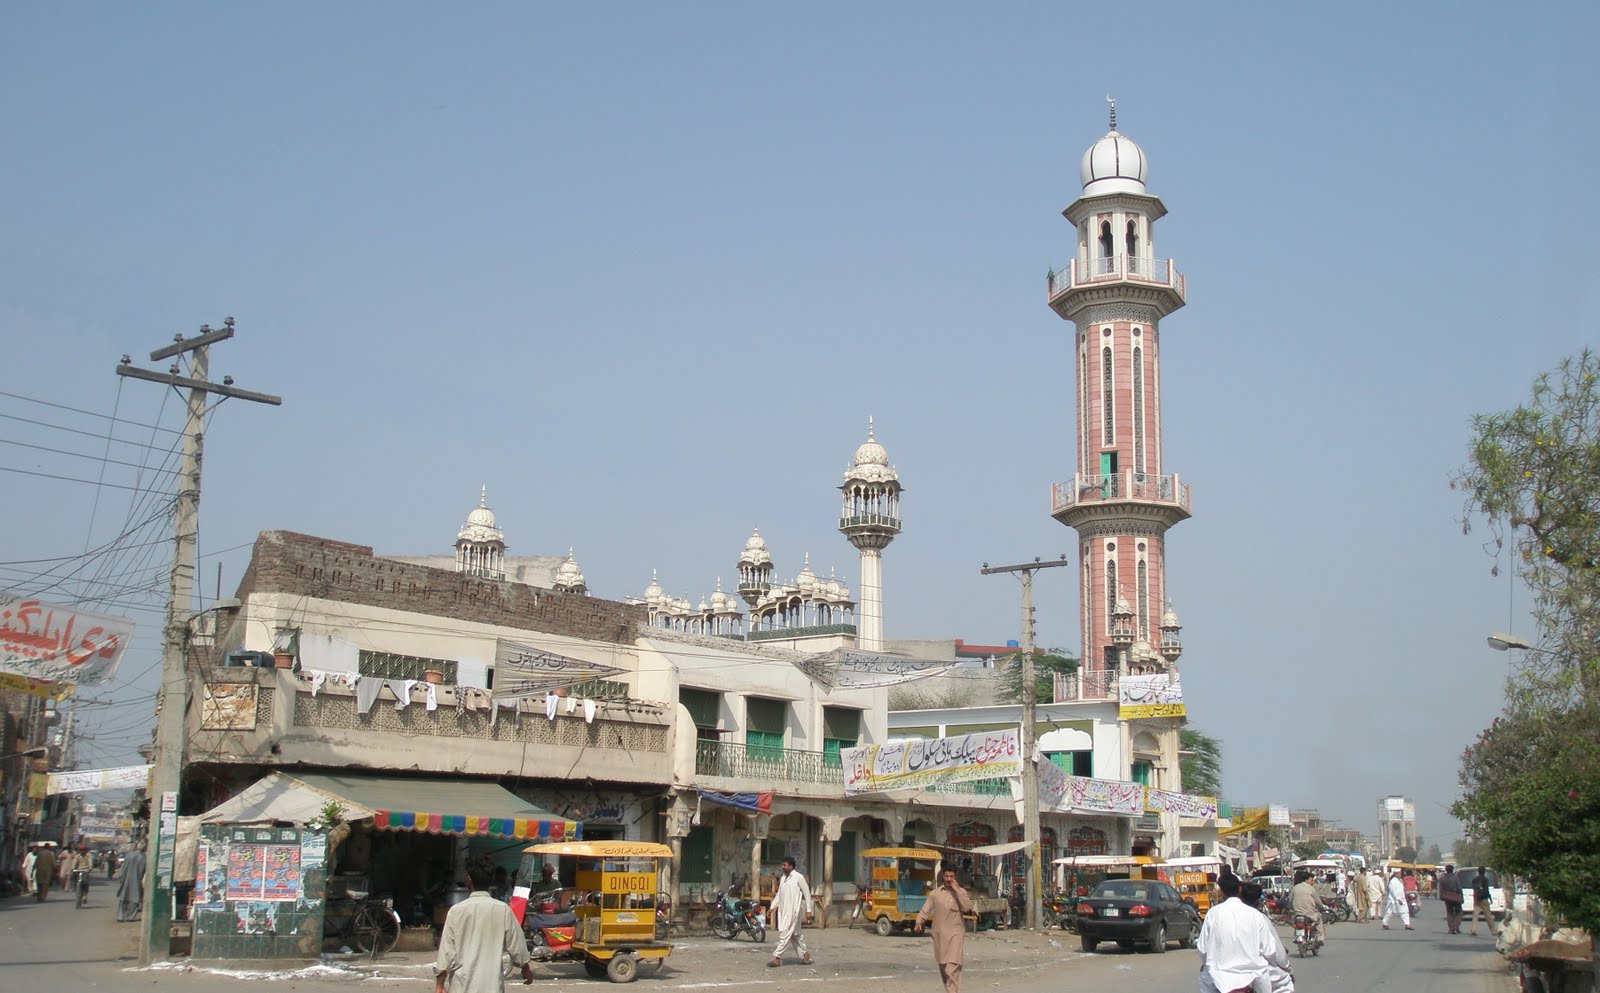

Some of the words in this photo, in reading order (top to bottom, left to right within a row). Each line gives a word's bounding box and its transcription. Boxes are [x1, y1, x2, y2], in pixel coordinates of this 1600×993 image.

[908, 740, 941, 770] سکول
[951, 735, 976, 765] پبلک
[988, 733, 1014, 761] فاطمہ
[610, 876, 649, 890] QINGQI
[1179, 874, 1203, 883] QINGQI
